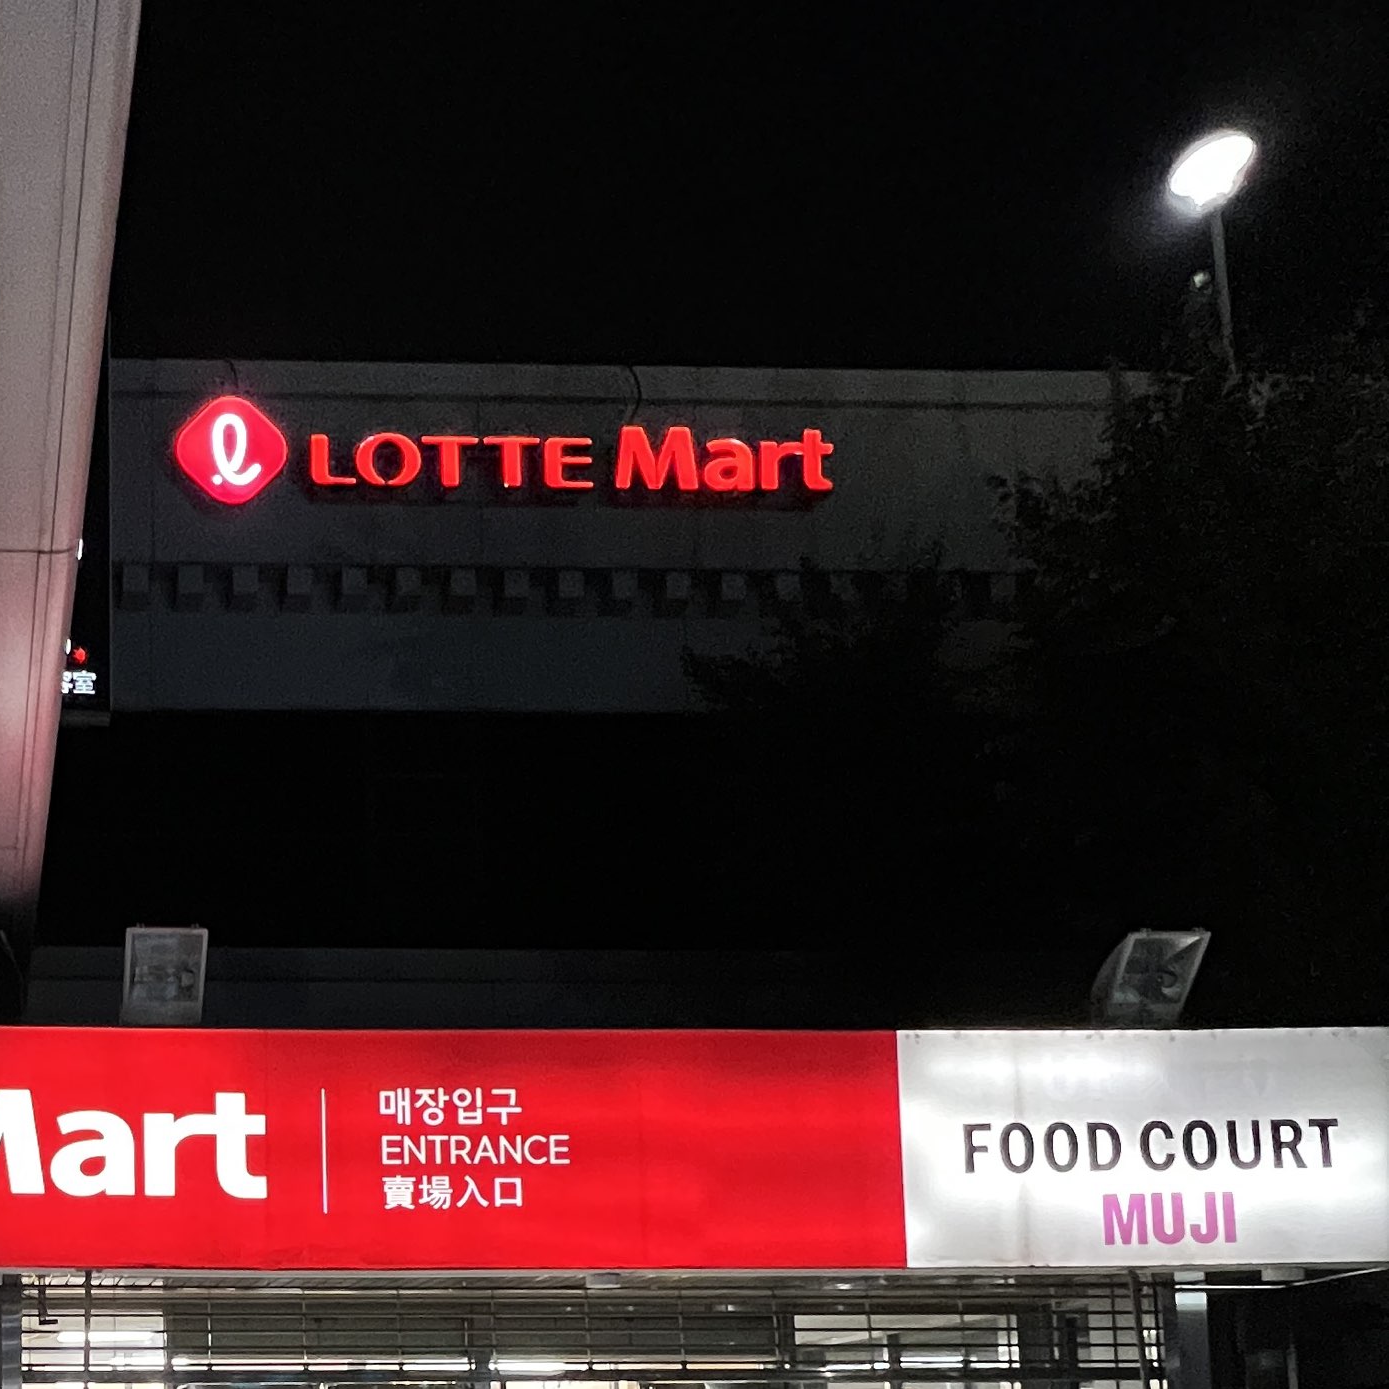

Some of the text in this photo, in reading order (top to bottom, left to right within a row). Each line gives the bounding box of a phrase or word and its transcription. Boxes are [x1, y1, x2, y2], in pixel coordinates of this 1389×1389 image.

[310, 425, 834, 491] LOTTE Mart
[379, 1087, 522, 1126] 매장입구
[381, 1134, 571, 1165] ENTRANCE
[963, 1118, 1339, 1173] FOOD COURT
[382, 1175, 523, 1210] 賣場入口
[1102, 1192, 1237, 1246] MUJI
